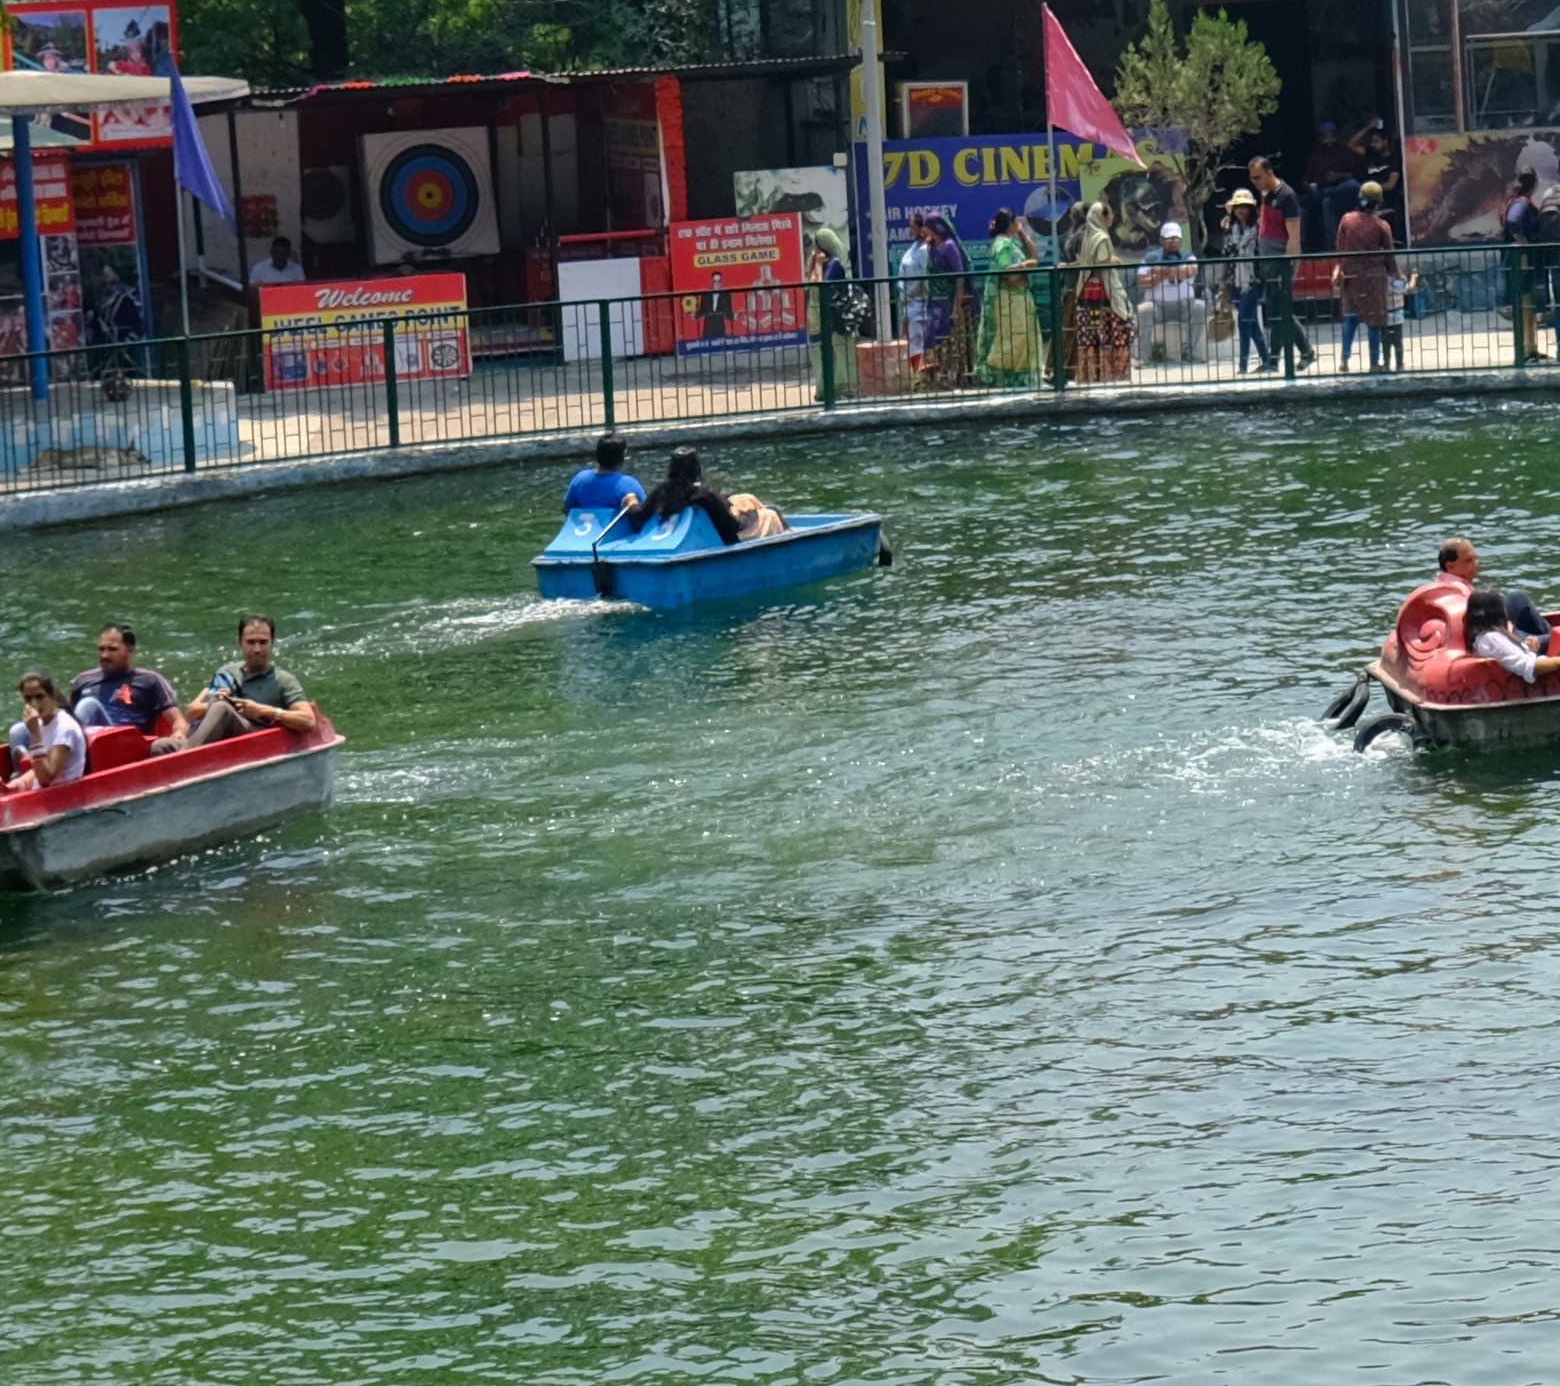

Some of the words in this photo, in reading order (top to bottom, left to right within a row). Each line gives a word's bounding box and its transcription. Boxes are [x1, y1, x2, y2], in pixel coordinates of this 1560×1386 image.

[883, 149, 940, 188] 7D
[885, 207, 902, 221] IR
[697, 253, 737, 265] GLASS
[741, 250, 776, 261] GAME
[314, 287, 413, 309] Welcome
